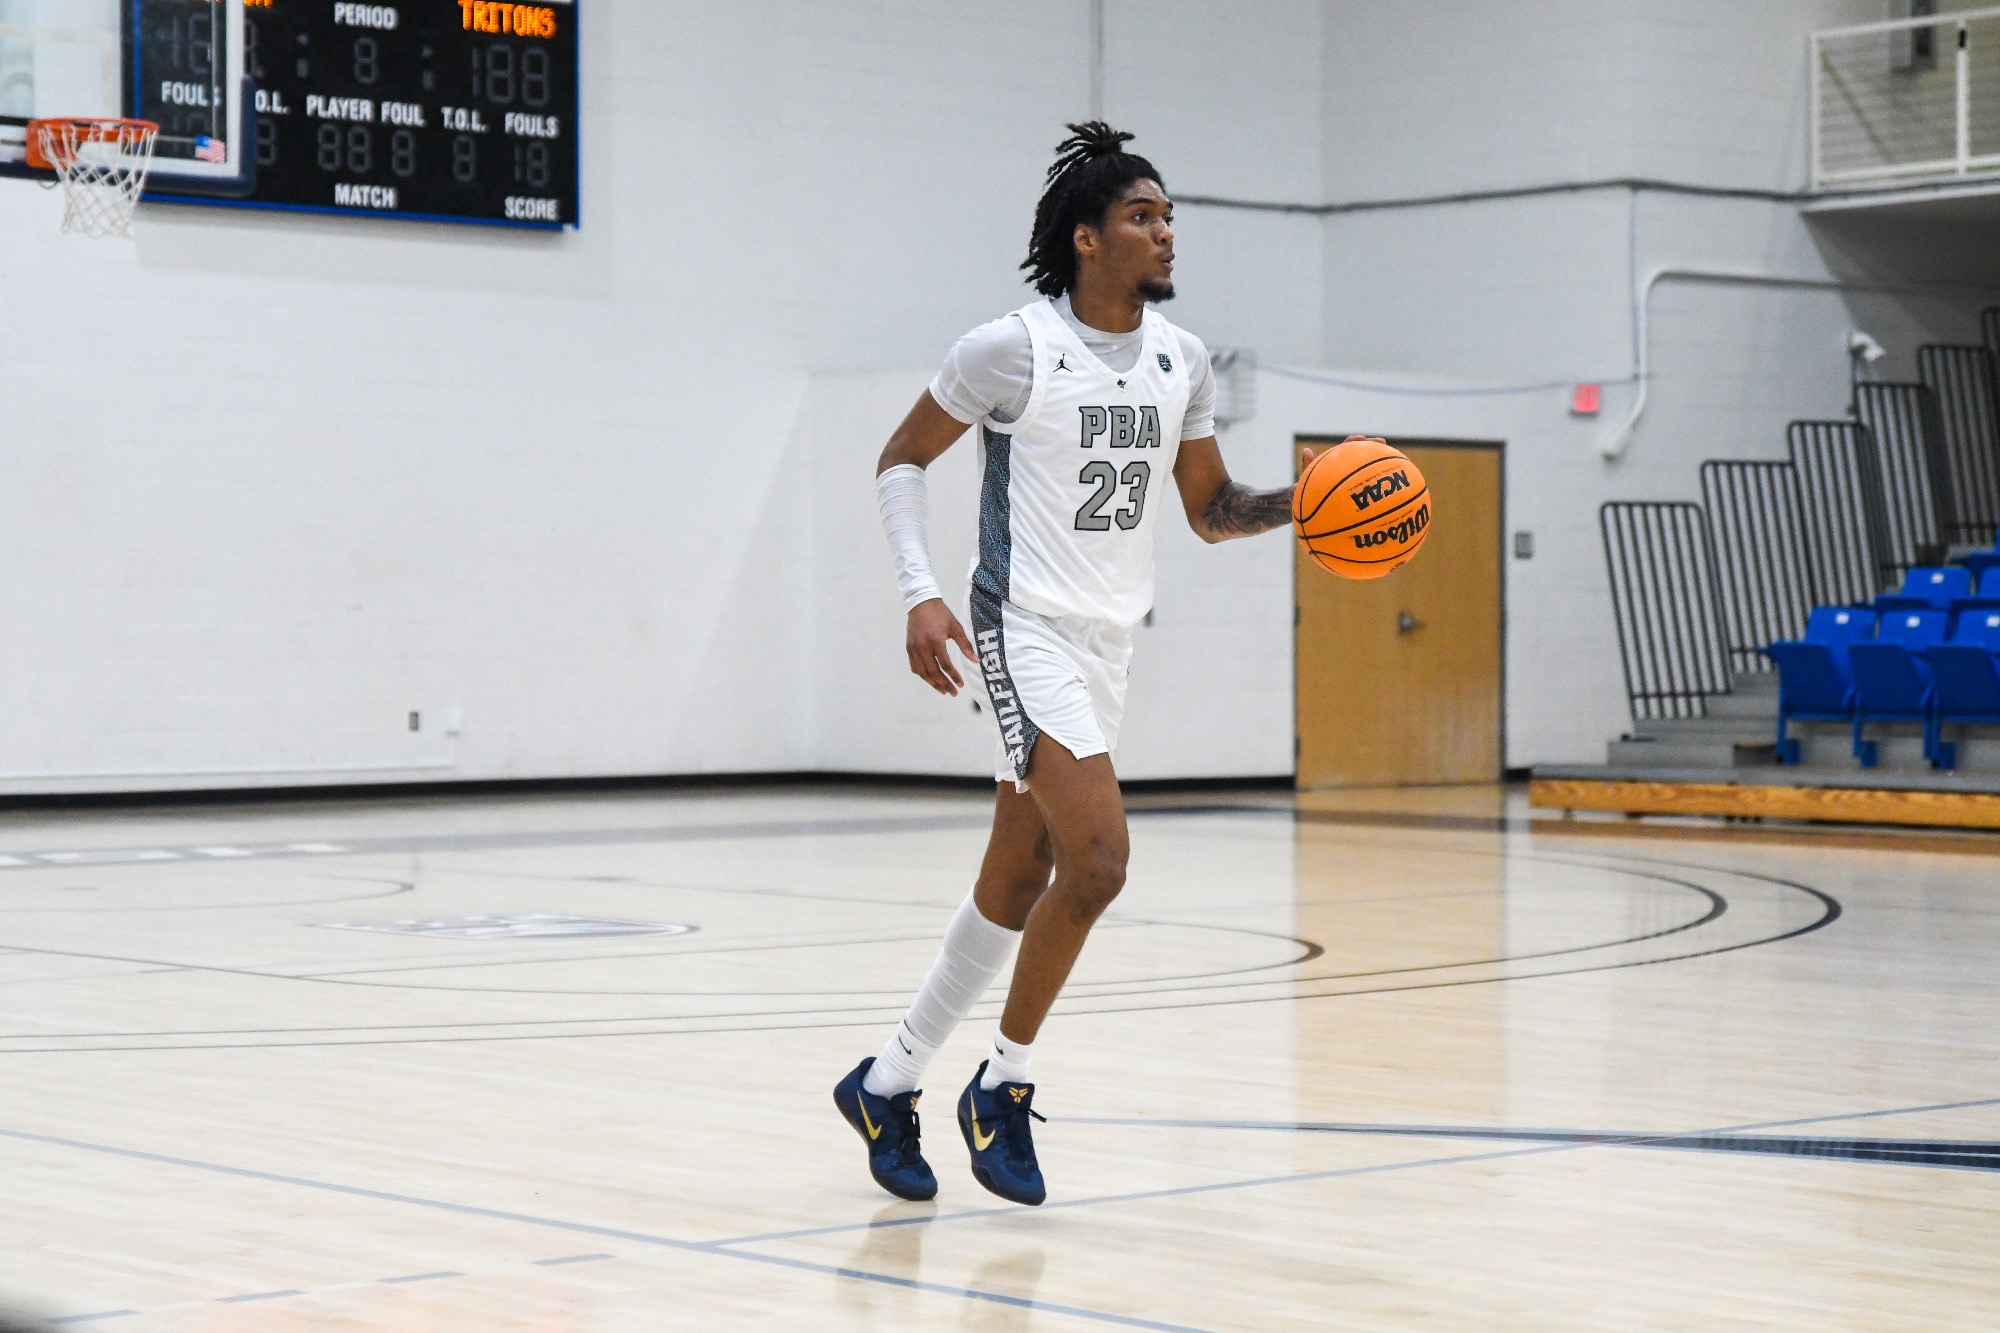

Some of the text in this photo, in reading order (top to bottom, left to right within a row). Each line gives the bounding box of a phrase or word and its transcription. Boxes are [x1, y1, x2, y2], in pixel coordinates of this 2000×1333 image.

[334, 2, 399, 30] PERIOD
[457, 0, 557, 39] TRITONS
[306, 94, 427, 128] PLAYER FOUL
[504, 112, 560, 139] FOULS
[334, 183, 399, 210] MATCH
[504, 196, 560, 221] SCORE
[1079, 406, 1161, 448] PBA
[1074, 461, 1151, 531] 23
[1350, 469, 1411, 511] NCAA
[1353, 503, 1429, 548] Wilson
